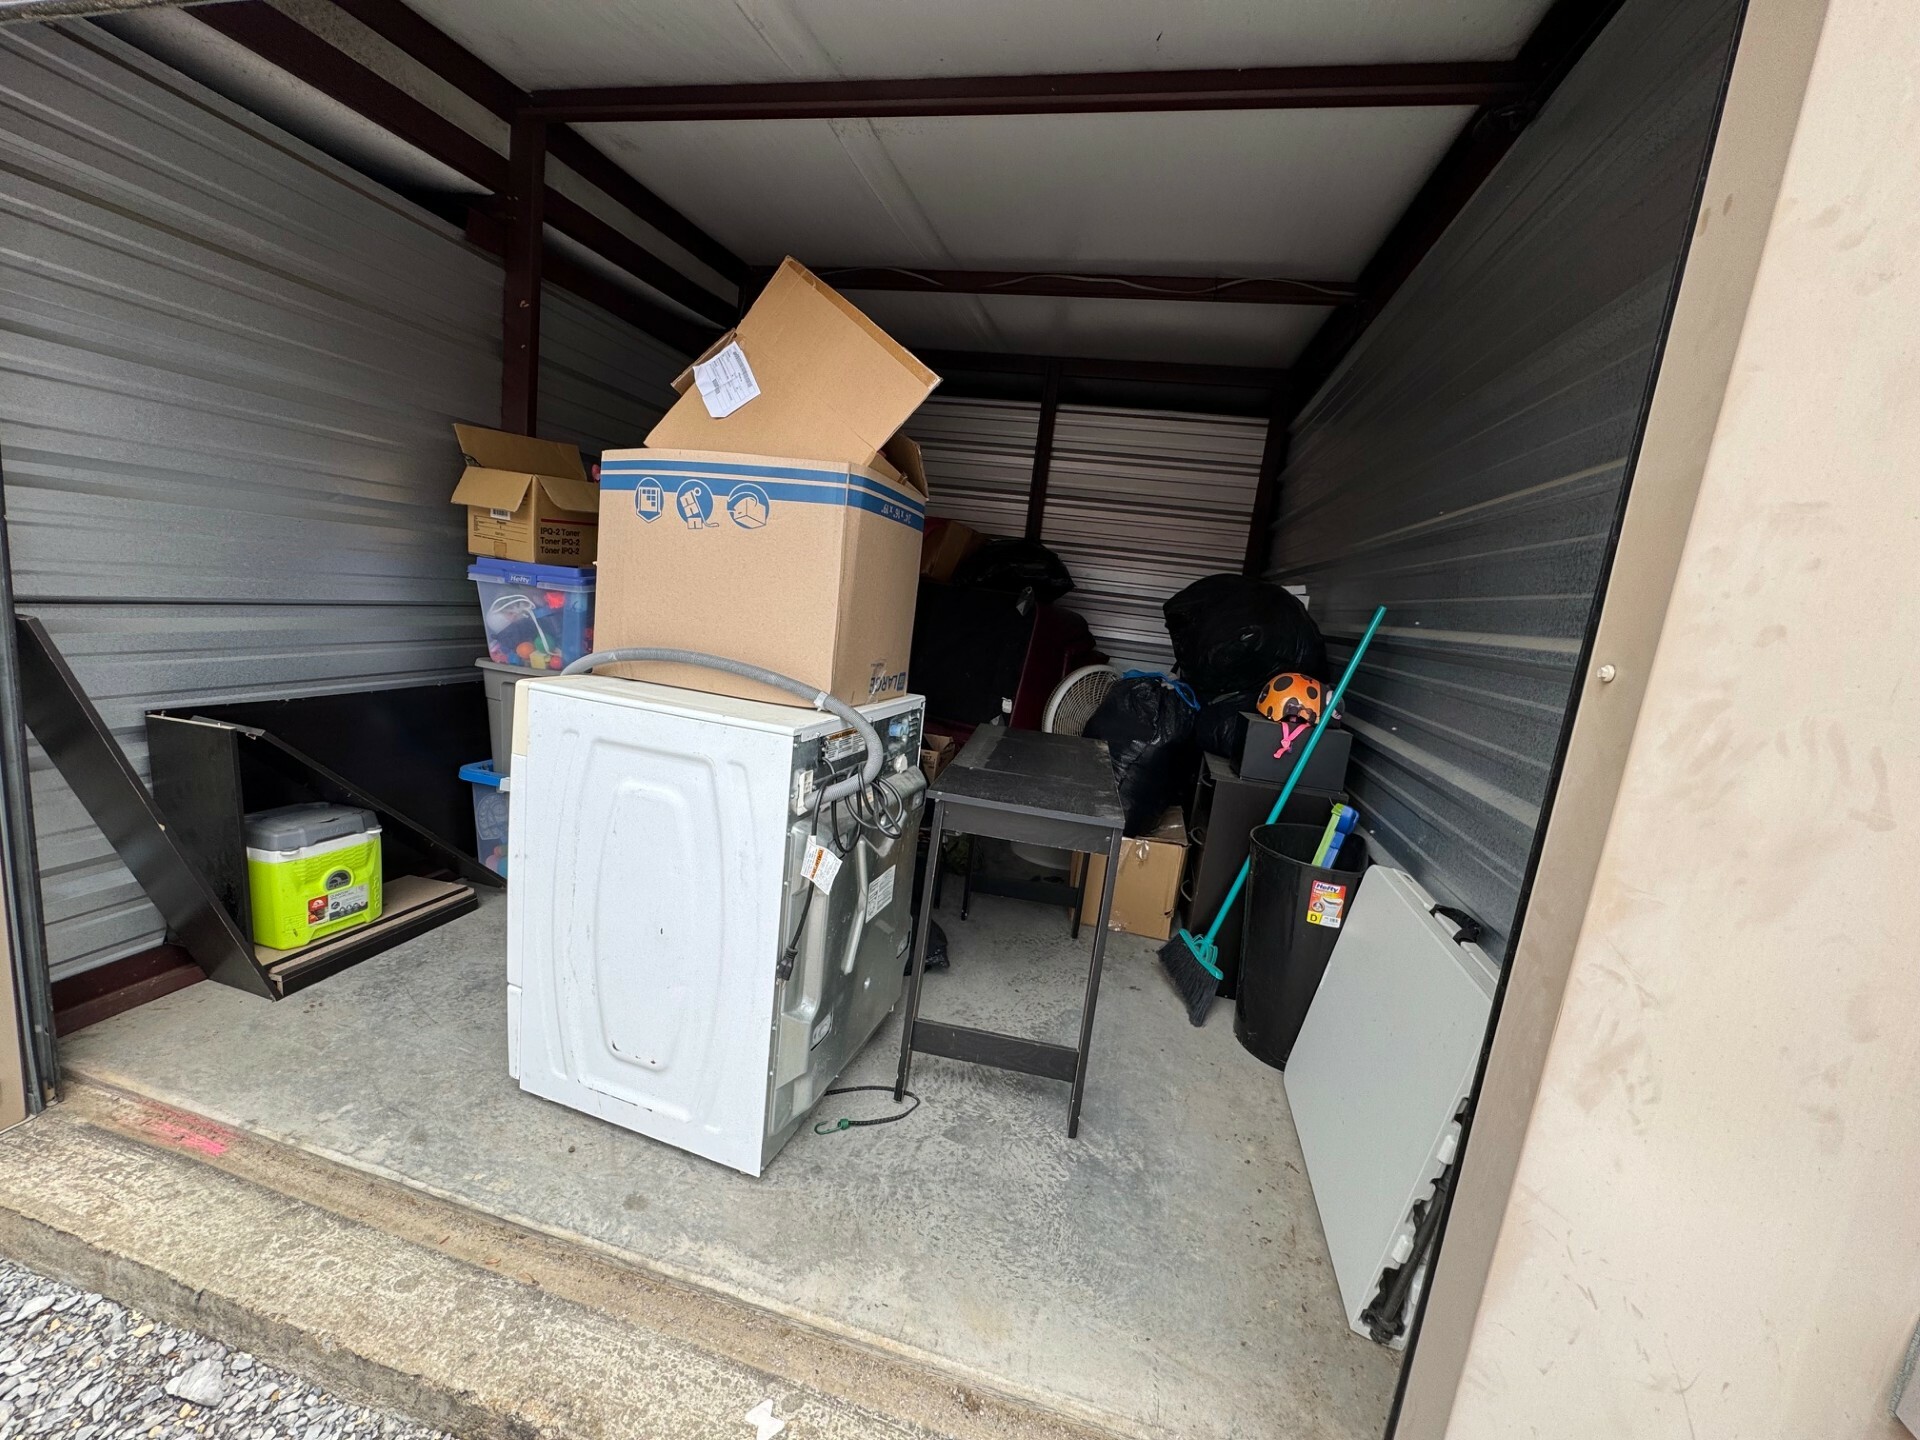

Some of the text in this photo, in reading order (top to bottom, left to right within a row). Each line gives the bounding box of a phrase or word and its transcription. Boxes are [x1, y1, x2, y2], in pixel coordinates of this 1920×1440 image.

[540, 527, 580, 537] IPQ-2 Toner
[540, 536, 580, 546] Toner IPQ-2
[561, 547, 580, 555] IPQ-2
[510, 575, 530, 585] Hefty
[869, 675, 898, 693] LARGE
[1316, 883, 1338, 894] Hefty
[1310, 914, 1318, 922] D
